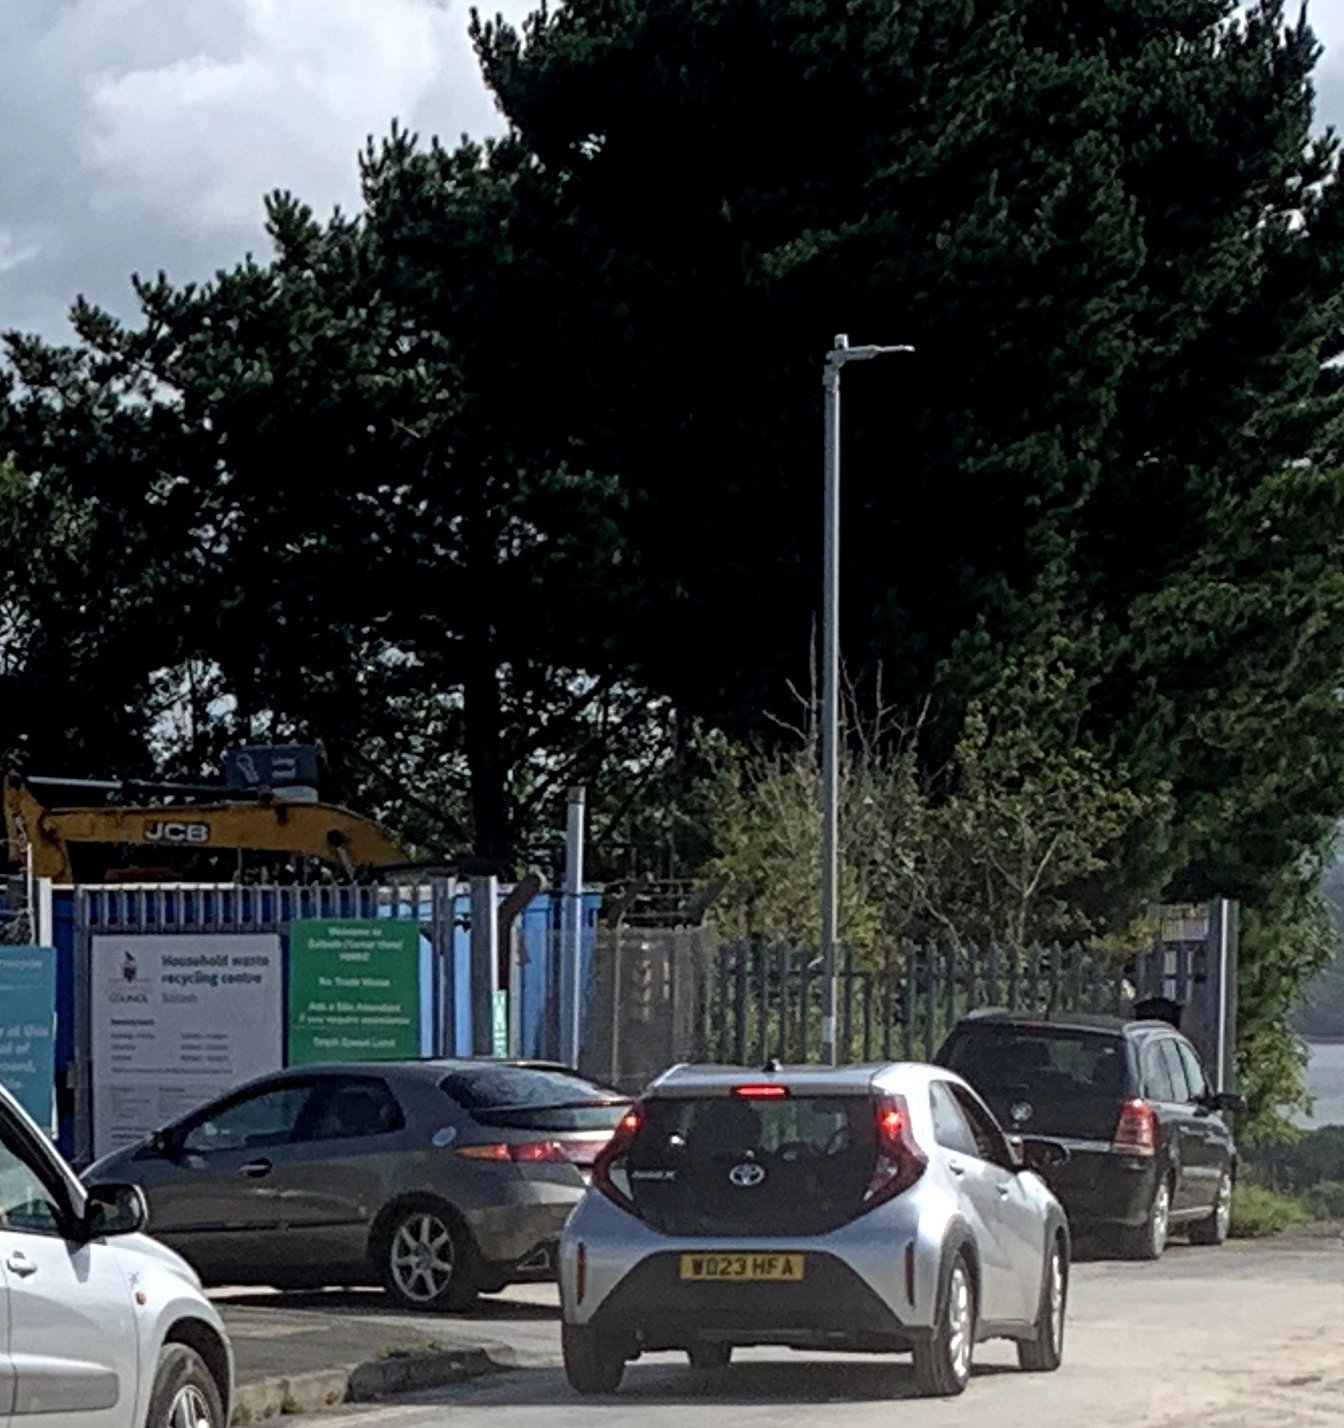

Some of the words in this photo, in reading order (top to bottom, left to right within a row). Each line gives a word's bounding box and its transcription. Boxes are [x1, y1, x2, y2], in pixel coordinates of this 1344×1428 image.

[145, 823, 209, 841] JCB
[162, 954, 228, 967] Household
[162, 971, 218, 987] recycling
